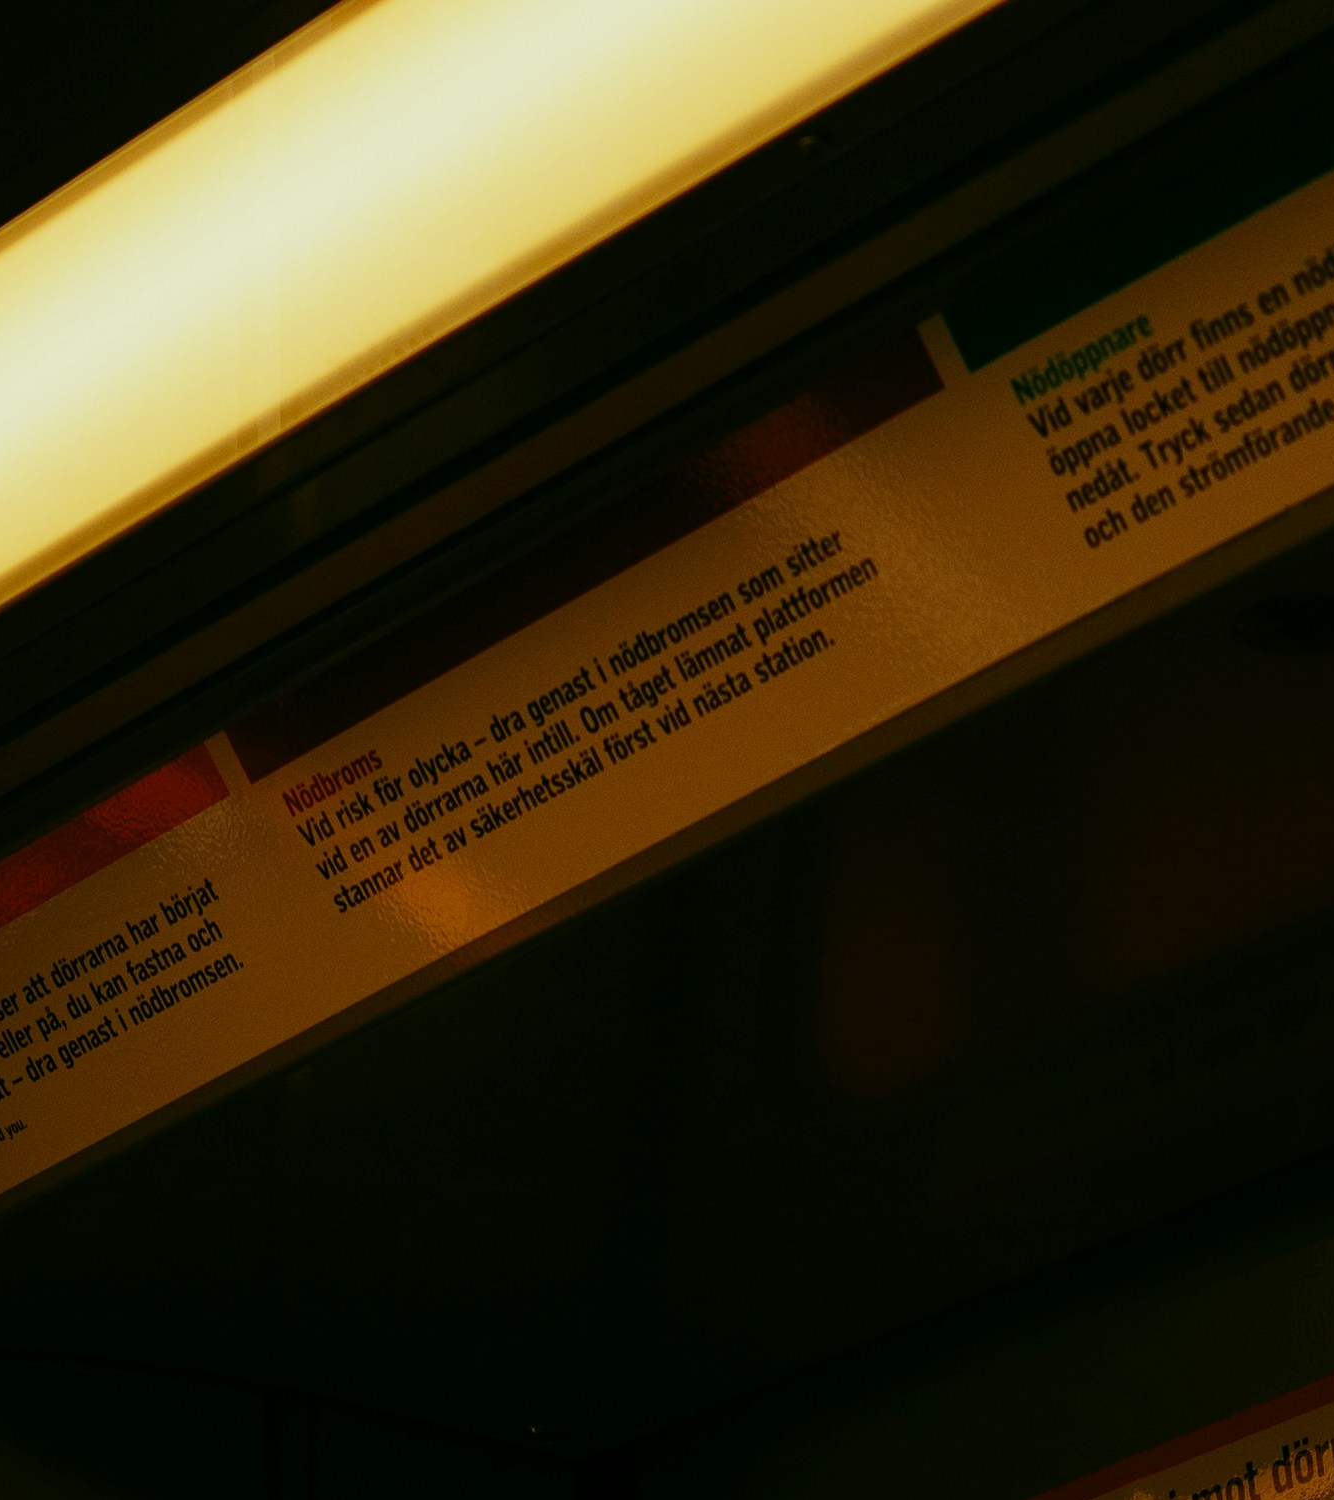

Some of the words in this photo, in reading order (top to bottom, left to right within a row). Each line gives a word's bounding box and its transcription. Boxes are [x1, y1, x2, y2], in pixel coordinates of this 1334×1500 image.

[1009, 314, 1154, 406] Nödöppnare
[1083, 508, 1129, 550] och
[1130, 485, 1177, 524] den
[314, 844, 349, 881] vid
[349, 836, 377, 864] en
[375, 820, 401, 849] av
[403, 774, 490, 834] dörrarna
[485, 750, 524, 787] här
[523, 719, 581, 766] intill.
[579, 700, 620, 735] Om
[617, 664, 678, 713] tåget
[673, 622, 753, 683] lämnat
[752, 557, 879, 647] plattformen
[280, 748, 383, 818] Nödbroms
[332, 859, 405, 914] stannar
[407, 836, 444, 873] det
[442, 825, 468, 854] av
[469, 745, 605, 840] säkerhetsskäl
[602, 718, 658, 765] först
[655, 697, 693, 736] vid
[692, 671, 753, 718] nästa
[753, 629, 836, 684] station.
[21, 972, 52, 1005] att
[50, 933, 130, 989] dörrarna
[124, 912, 160, 946] har
[158, 877, 220, 927] börjat
[4, 1118, 29, 1141] you.
